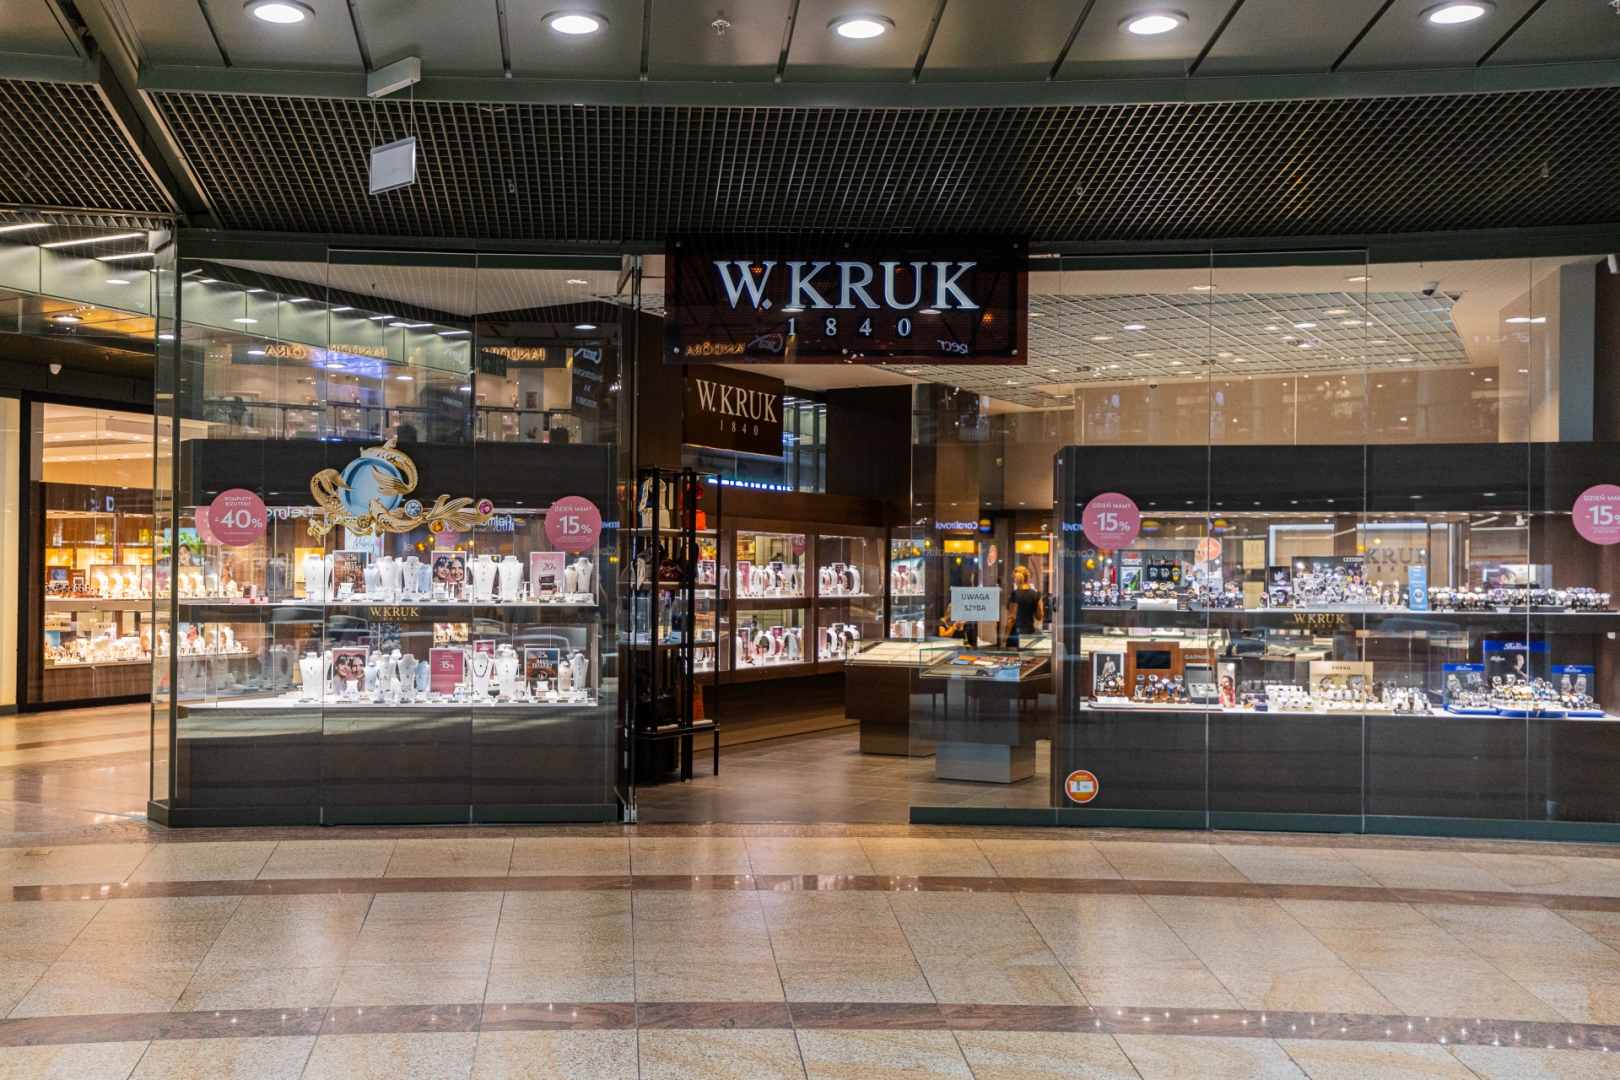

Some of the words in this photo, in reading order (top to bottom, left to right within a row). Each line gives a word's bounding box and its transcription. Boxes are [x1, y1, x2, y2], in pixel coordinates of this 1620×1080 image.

[788, 317, 912, 336] 1840
[720, 420, 759, 436] 1840
[557, 515, 592, 534] -15%
[1093, 512, 1130, 531] -15%
